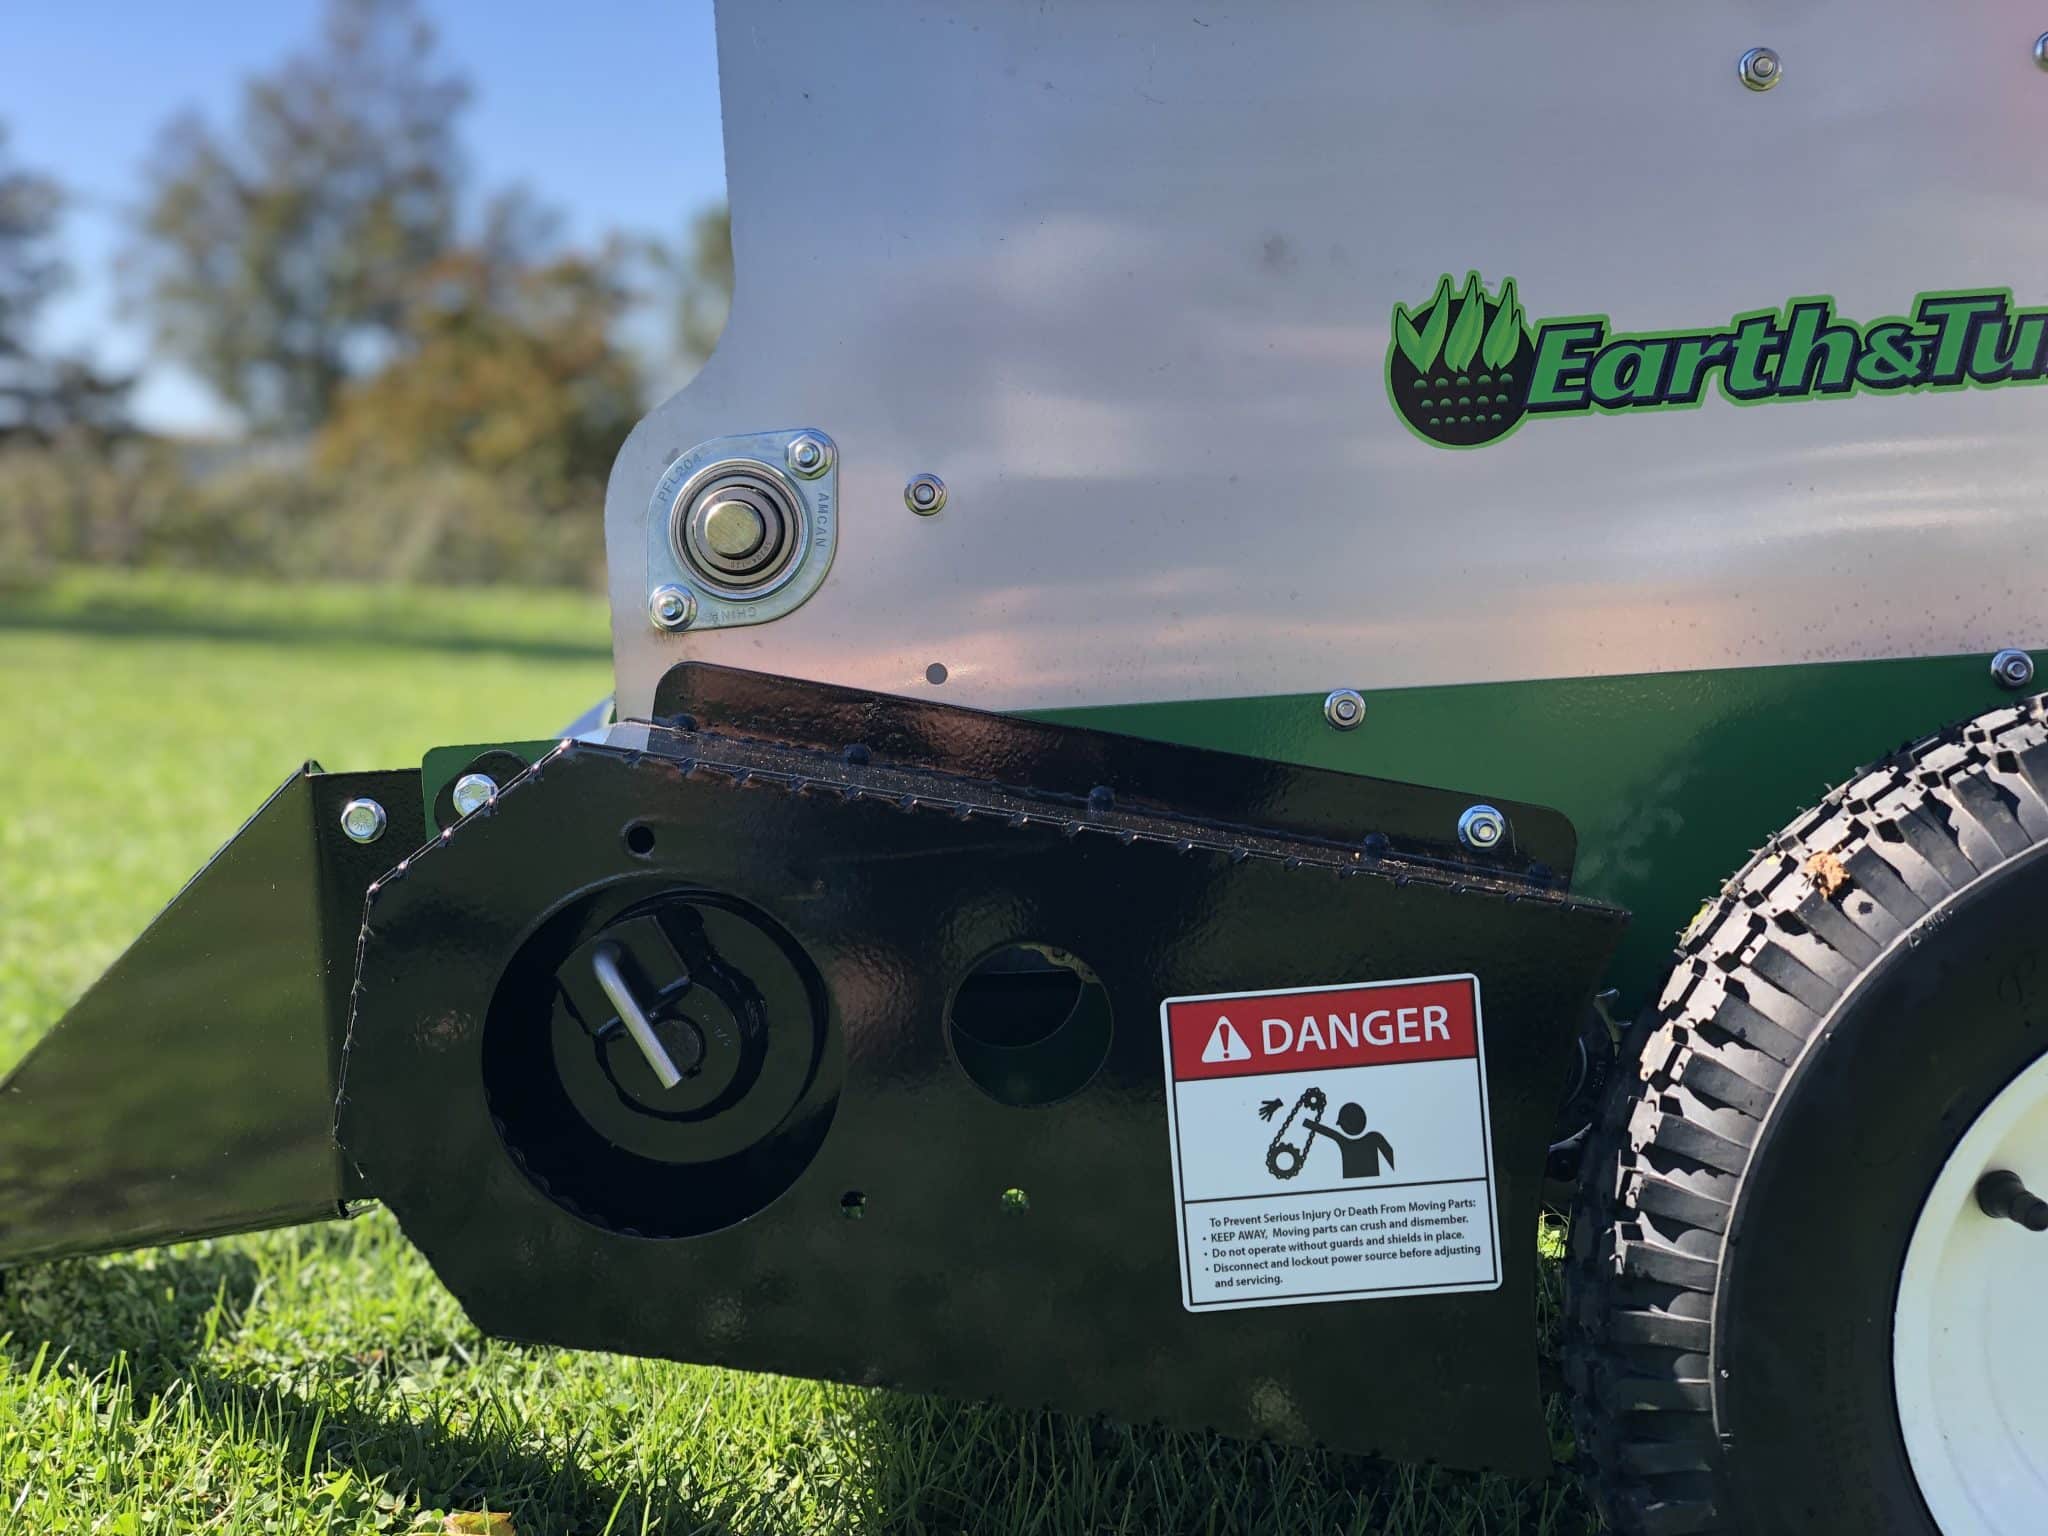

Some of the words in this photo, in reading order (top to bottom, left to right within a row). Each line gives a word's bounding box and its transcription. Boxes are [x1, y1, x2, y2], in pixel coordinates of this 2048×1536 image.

[658, 454, 702, 502] PFL204
[816, 492, 829, 547] AMCAN
[711, 606, 757, 625] CHINA
[1262, 1005, 1451, 1055] DANGER
[1209, 1217, 1222, 1228] To
[1223, 1215, 1262, 1227] Prevent
[1263, 1212, 1301, 1224] Serious
[1301, 1209, 1332, 1222] Injury
[1333, 1207, 1346, 1218] Or
[1348, 1204, 1379, 1217] Death
[1380, 1203, 1407, 1215] From
[1408, 1200, 1447, 1213] Moving
[1447, 1198, 1476, 1209] Parts:
[1210, 1231, 1236, 1243] KEEP
[1238, 1228, 1268, 1241] AWAY,
[1272, 1226, 1311, 1238] Moving
[1312, 1224, 1338, 1238] parts
[1339, 1224, 1358, 1233] can
[1359, 1218, 1387, 1231] crush
[1389, 1217, 1408, 1229] and
[1410, 1214, 1469, 1228] dismember.
[1212, 1248, 1227, 1259] Do
[1228, 1247, 1246, 1257] not
[1247, 1244, 1287, 1258] operate
[1288, 1240, 1328, 1252] without
[1329, 1238, 1364, 1252] guards
[1365, 1234, 1385, 1246] and
[1387, 1232, 1422, 1245] shields
[1423, 1231, 1434, 1242] in
[1435, 1229, 1465, 1244] place.
[1213, 1260, 1269, 1273] Disconnect
[1270, 1256, 1290, 1269] and
[1291, 1255, 1329, 1267] lockout
[1331, 1254, 1363, 1267] power
[1364, 1251, 1398, 1262] source
[1399, 1247, 1433, 1259] before
[1434, 1244, 1481, 1258] adjusting
[1214, 1276, 1234, 1289] and
[1235, 1274, 1283, 1287] servicing.
